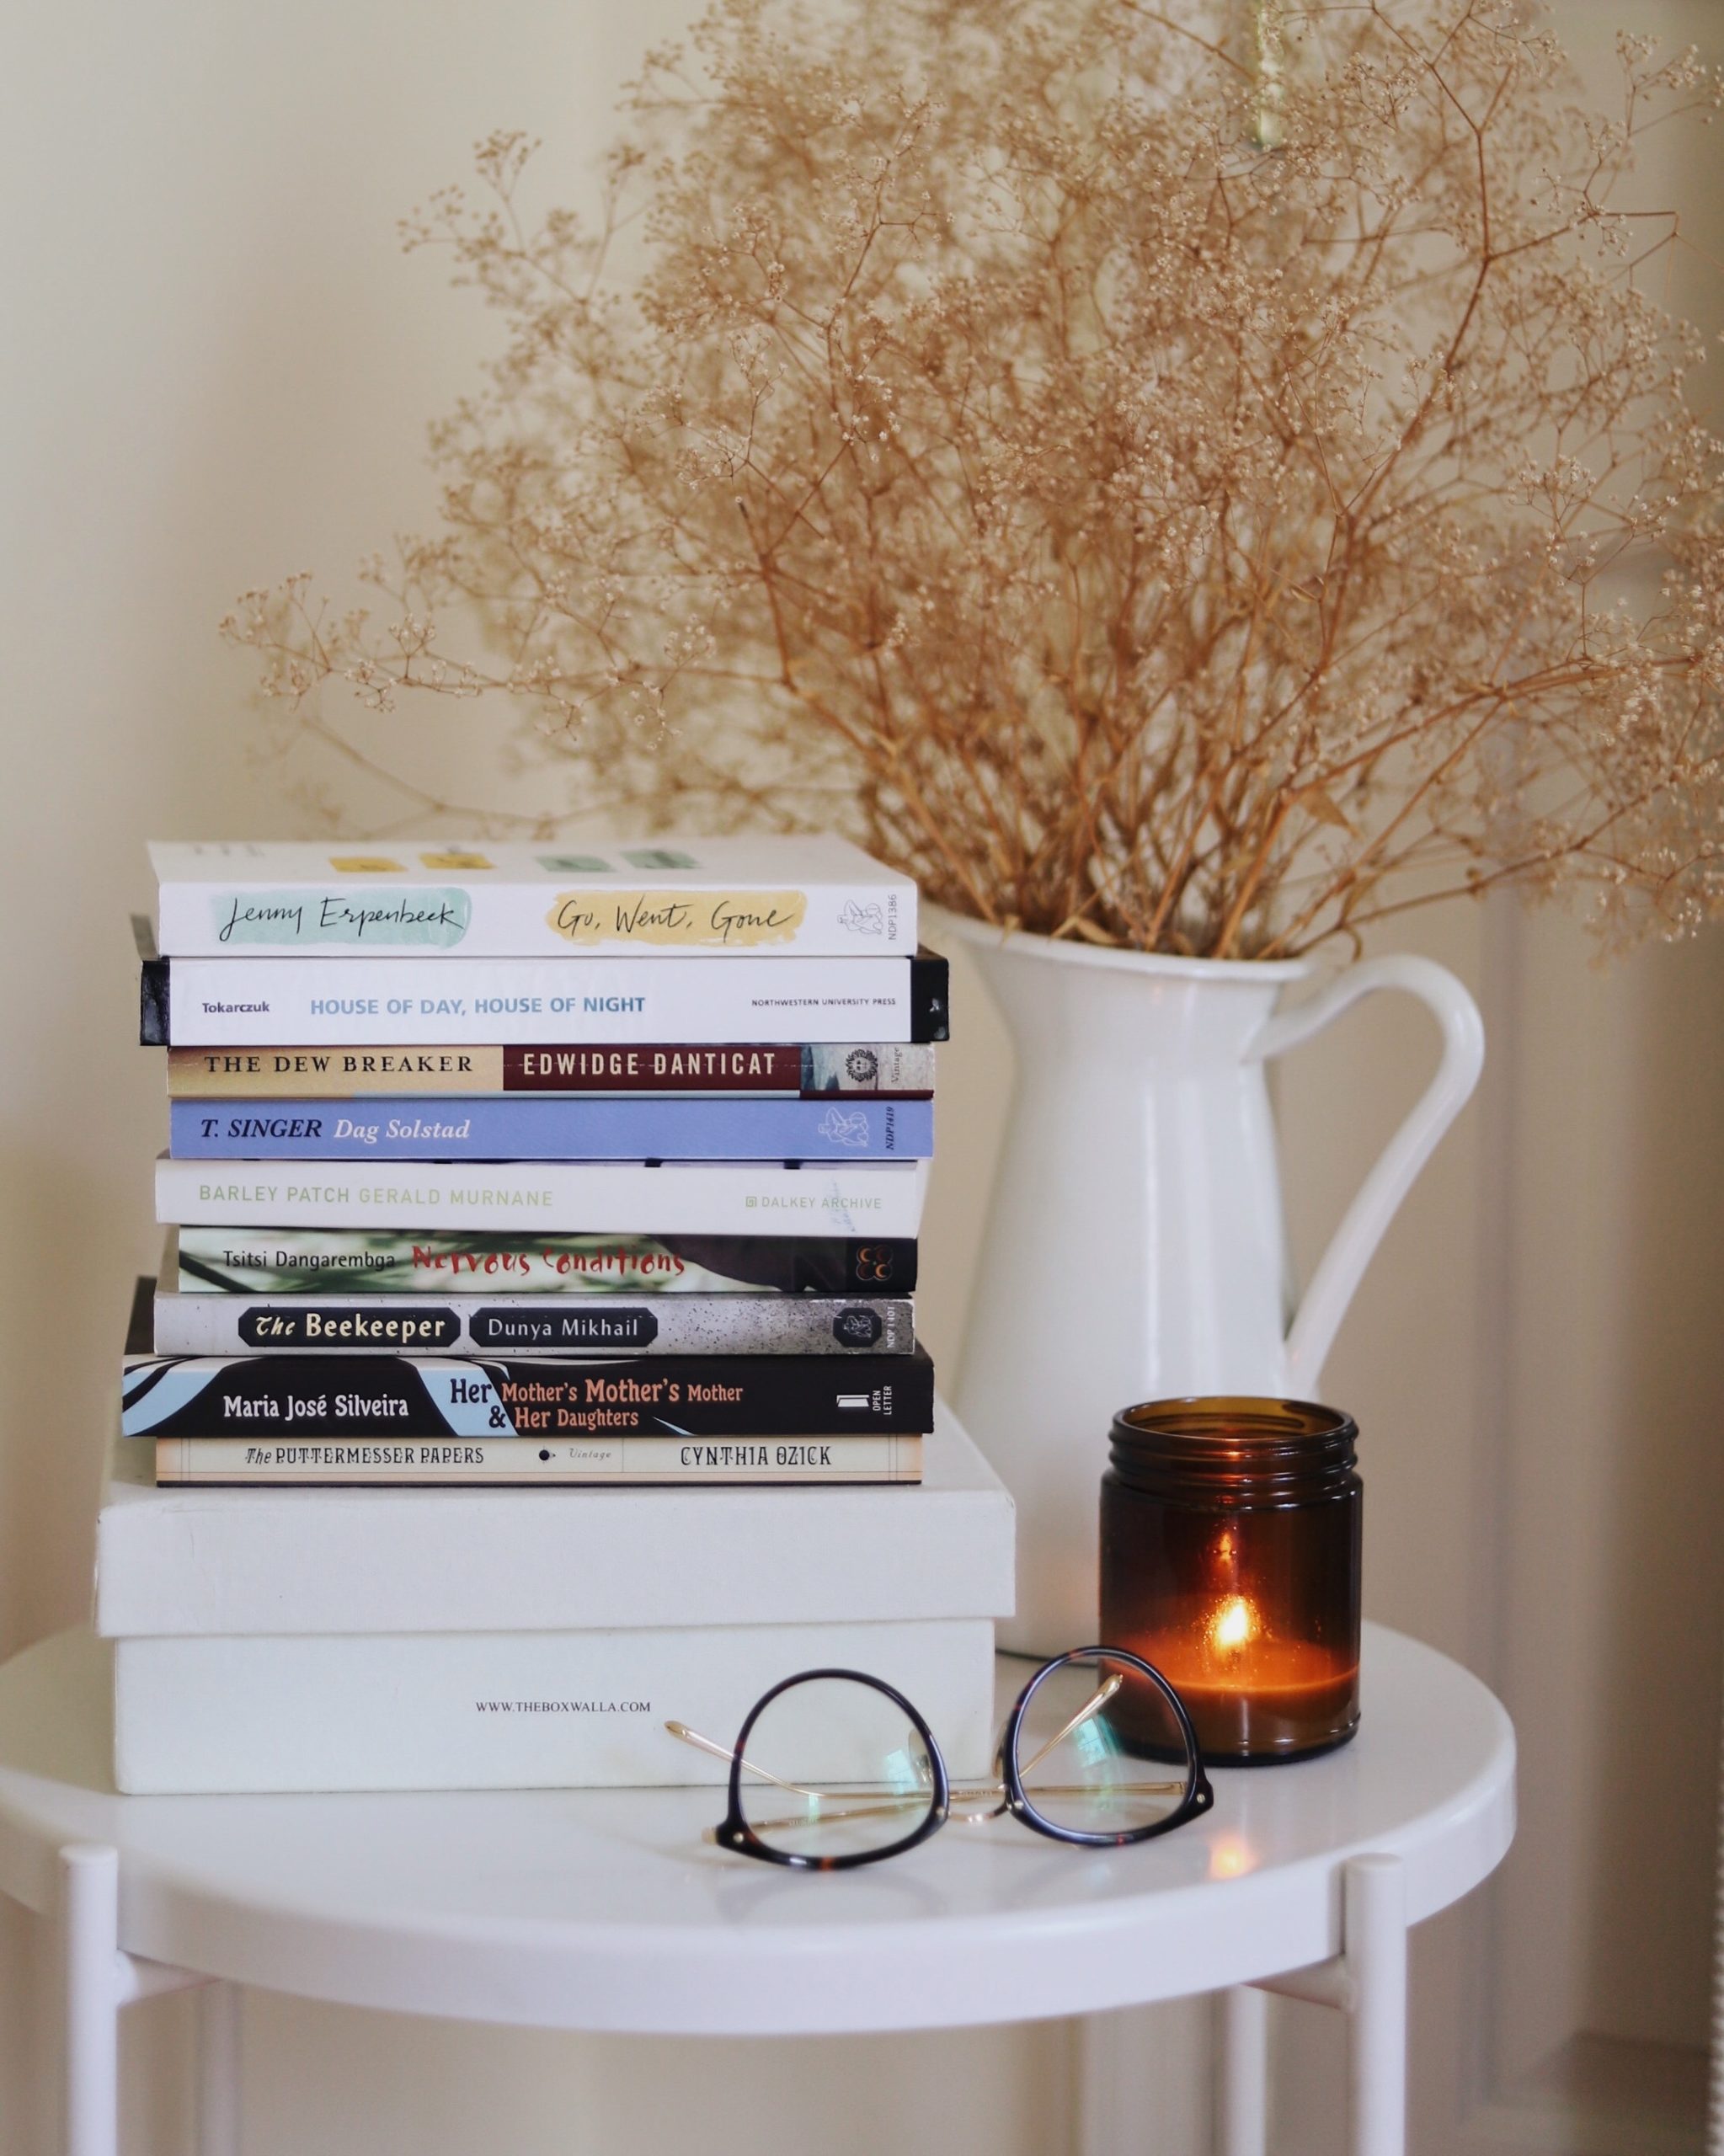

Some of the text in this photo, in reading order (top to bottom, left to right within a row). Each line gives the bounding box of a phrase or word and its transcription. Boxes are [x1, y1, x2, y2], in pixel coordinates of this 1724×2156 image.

[219, 897, 465, 942] Jenny Erpenbeck
[558, 894, 795, 943] Go, Went, Gone
[888, 894, 897, 941] NDP1386
[202, 1001, 270, 1014] Tokarczuk
[310, 997, 645, 1017] HOUSE OF DAY, HOUSE OF NIGHT
[751, 999, 819, 1007] NORTHWESTERN
[822, 998, 869, 1006] UNIVERSITY
[204, 1055, 473, 1072] THE DEW BREAKER
[524, 1053, 776, 1076] EDWIDGE DANTICAT
[891, 1047, 902, 1083] Vintage
[200, 1119, 322, 1138] T. SINGER
[334, 1119, 471, 1144] Dag Solstad
[886, 1107, 894, 1150] NDP1419
[200, 1185, 350, 1203] BARLEY PATCH
[360, 1187, 552, 1207] GERALD MURNANE
[762, 1197, 882, 1209] DALKEY ARCHIVE
[223, 1251, 395, 1271] Tsitsi Dangarembga
[411, 1246, 530, 1275] Nervous
[255, 1313, 446, 1343] The Beekeeper
[488, 1318, 638, 1341] Dunya Mikhail
[450, 1379, 743, 1404] Her Mother's Mother's Mother
[873, 1390, 881, 1412] OPEN
[883, 1385, 892, 1415] LETTER
[223, 1394, 408, 1422] Maria José Silveira
[488, 1406, 639, 1430] & Her Daughters
[245, 1448, 484, 1465] The PUTTERMESSER PAPERS
[681, 1446, 831, 1465] CYNTHIA OZICK
[476, 1701, 651, 1712] WWW.THEBOXWALLA.COM
